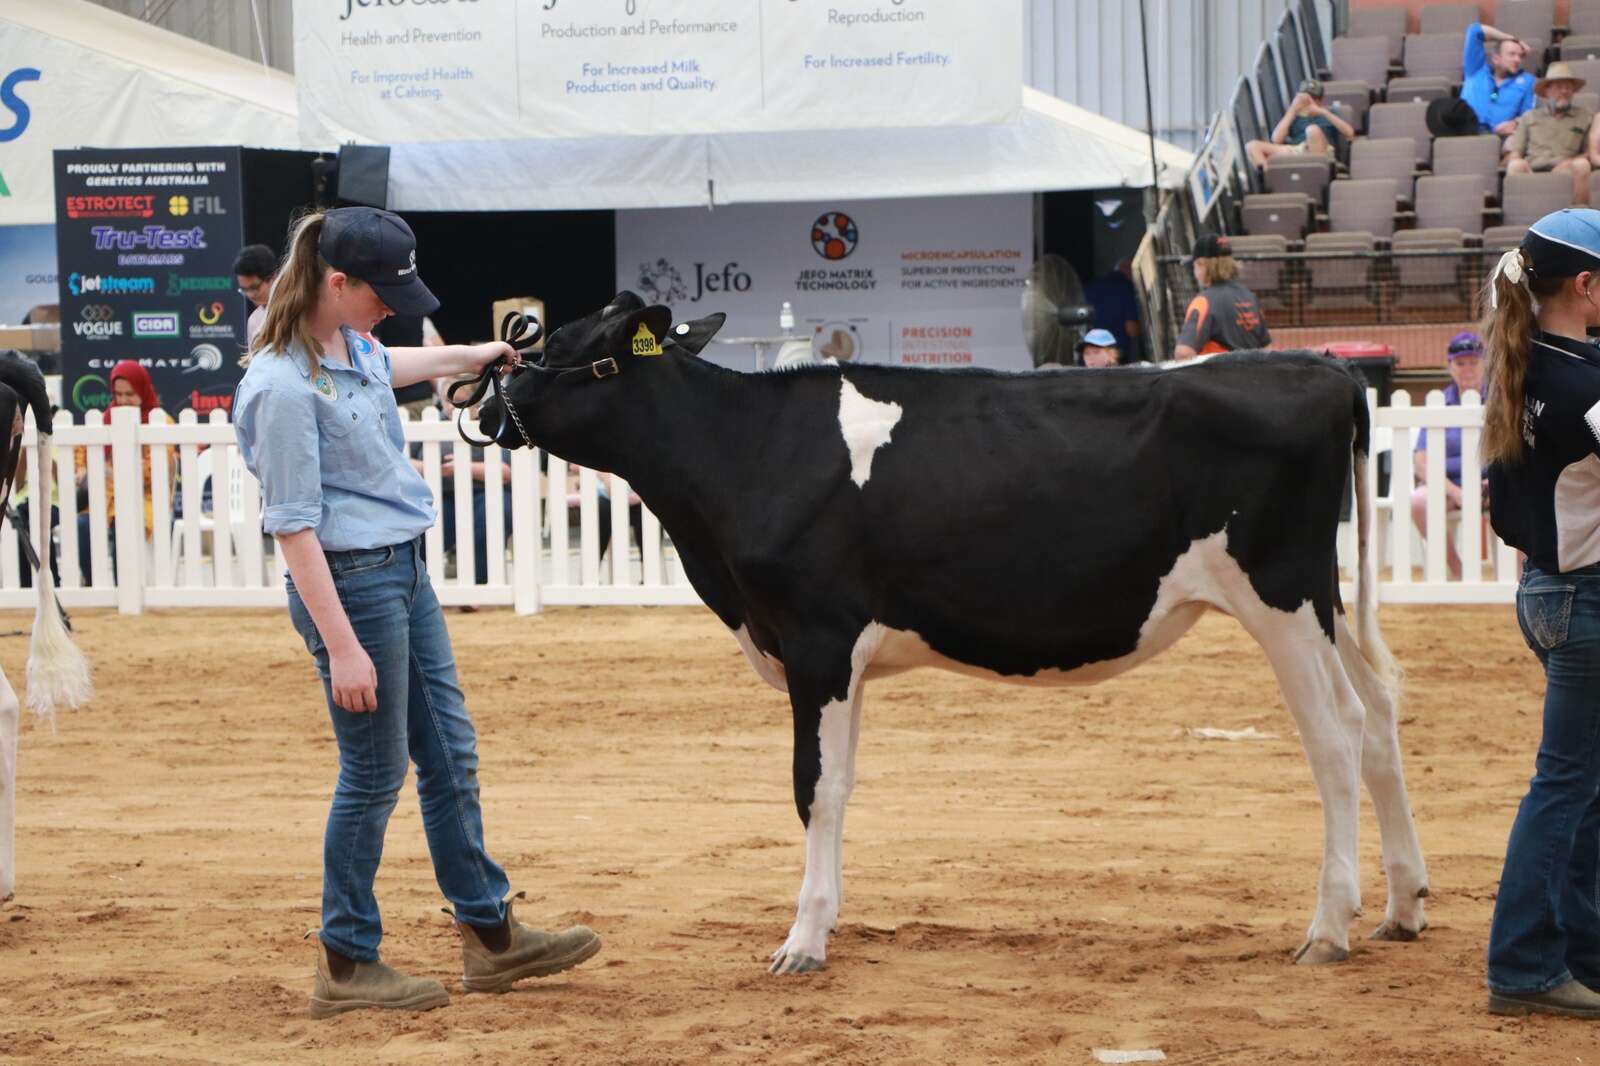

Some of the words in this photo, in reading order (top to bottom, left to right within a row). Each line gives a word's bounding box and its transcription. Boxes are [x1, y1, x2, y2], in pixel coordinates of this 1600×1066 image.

[827, 9, 925, 24] Reproduction
[541, 21, 616, 38] Production
[619, 22, 646, 36] and
[649, 18, 737, 33] Performance
[341, 30, 382, 46] Health
[385, 30, 409, 45] and
[412, 27, 481, 42] Prevention
[804, 54, 826, 69] For
[830, 53, 893, 68] Increased
[896, 51, 951, 66] Fertility.
[351, 70, 370, 84] For
[373, 69, 430, 84] Improved
[433, 66, 474, 80] Health
[582, 62, 605, 77] For
[608, 60, 668, 76] Increased
[671, 59, 700, 73] Milk
[380, 87, 393, 99] at
[395, 83, 443, 101] Calving.
[566, 78, 636, 94] Production
[640, 77, 664, 92] and
[667, 75, 718, 93] Quality.
[67, 163, 119, 174] PROUDLY
[122, 162, 194, 173] PARTNERING
[197, 161, 226, 172] WITH
[86, 176, 143, 187] GENETICS
[145, 174, 208, 186] AUSTRALIA
[66, 195, 155, 210] ESTROTECT
[193, 196, 226, 215] FIL
[91, 224, 207, 250] Tru-Test
[799, 270, 827, 282] JEFO
[829, 268, 874, 281] MATRIX
[901, 266, 949, 277] SUPERIOR
[951, 264, 1016, 276] PROTECTION
[25, 273, 58, 284] GOLD
[691, 262, 753, 302] Jefo
[795, 280, 877, 292] TECHNOLOGY
[901, 280, 922, 290] FOR
[923, 278, 960, 289] ACTIVE
[73, 320, 123, 336] VOGUE
[138, 318, 174, 332] CIDR
[902, 327, 973, 339] PRECISION
[633, 338, 656, 354] 3398
[88, 357, 192, 369] CUMATE
[902, 351, 973, 364] NUTRITION
